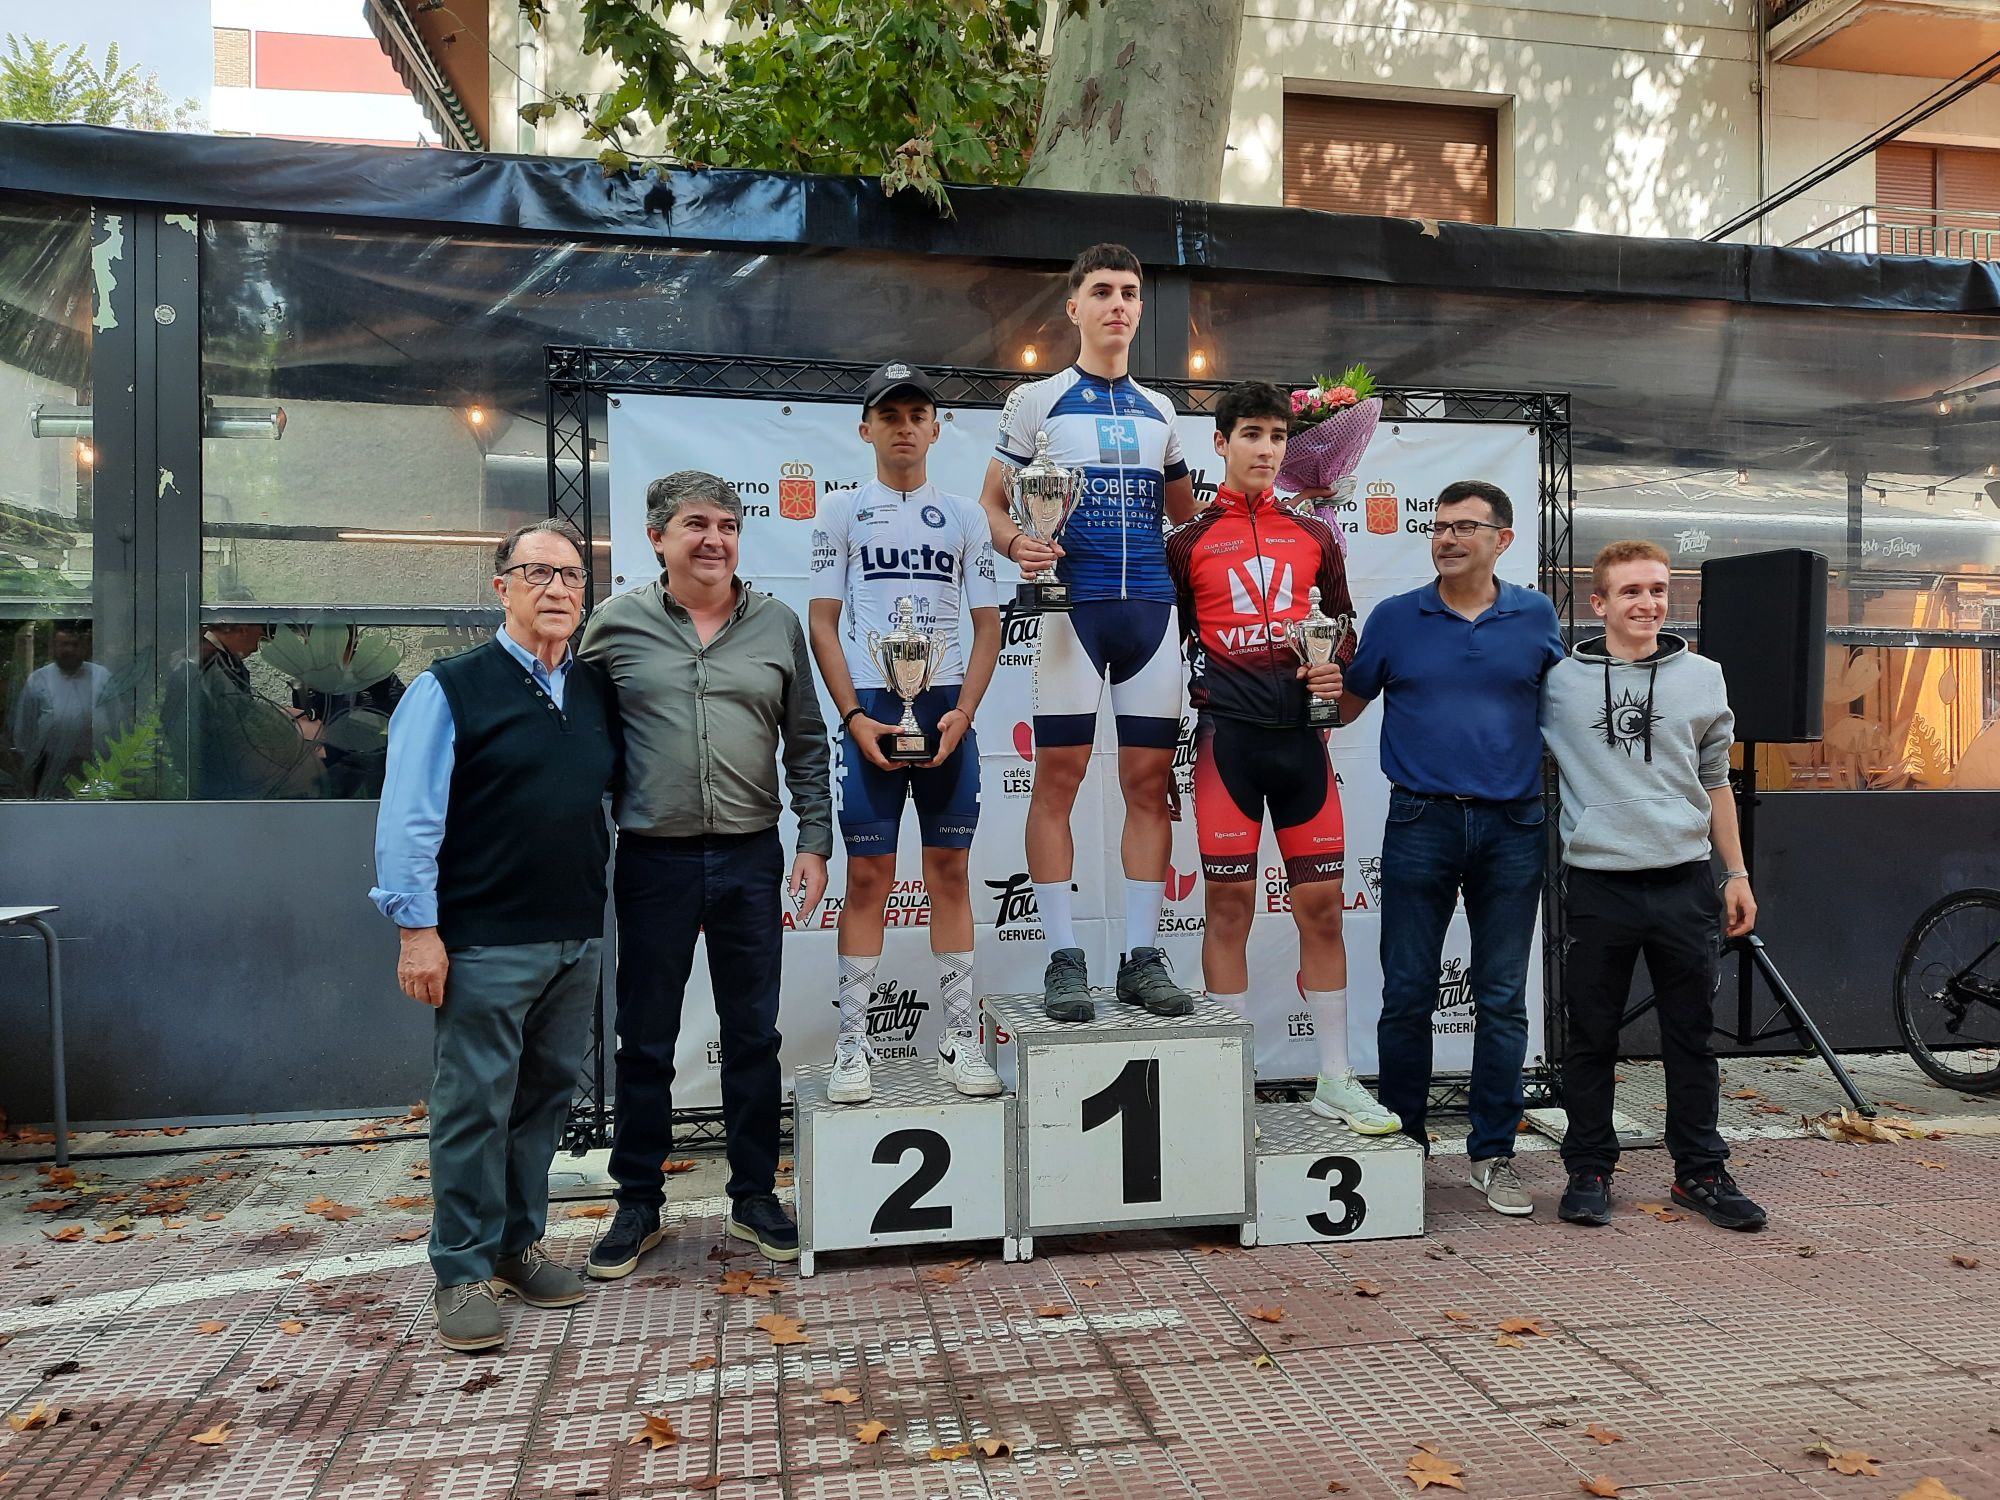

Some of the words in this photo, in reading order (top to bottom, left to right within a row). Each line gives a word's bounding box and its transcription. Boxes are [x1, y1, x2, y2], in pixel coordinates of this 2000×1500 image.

[1080, 496, 1157, 509] INNOVA
[1003, 768, 1031, 778] cafés
[1003, 780, 1034, 793] LES
[1204, 863, 1250, 876] VIZCAY
[1158, 918, 1206, 932] ESAGA
[877, 980, 898, 1005] The
[1288, 1023, 1315, 1036] LES
[1082, 1058, 1163, 1204] 1
[871, 1128, 954, 1235] 2
[1306, 1155, 1368, 1237] 3
